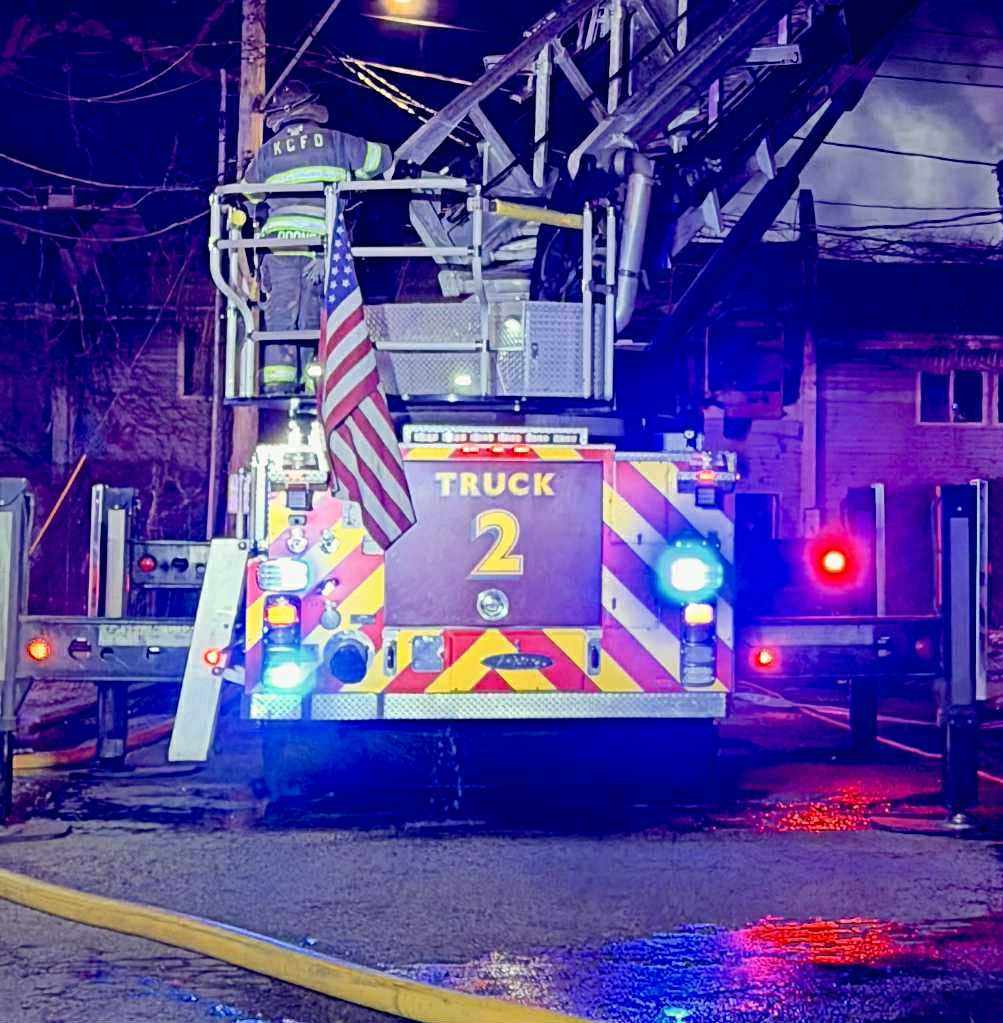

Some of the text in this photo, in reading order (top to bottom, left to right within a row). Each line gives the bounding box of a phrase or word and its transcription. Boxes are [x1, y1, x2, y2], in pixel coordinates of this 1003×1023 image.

[273, 133, 323, 156] KCFD
[435, 472, 556, 496] TRUCK
[468, 509, 524, 577] 2
